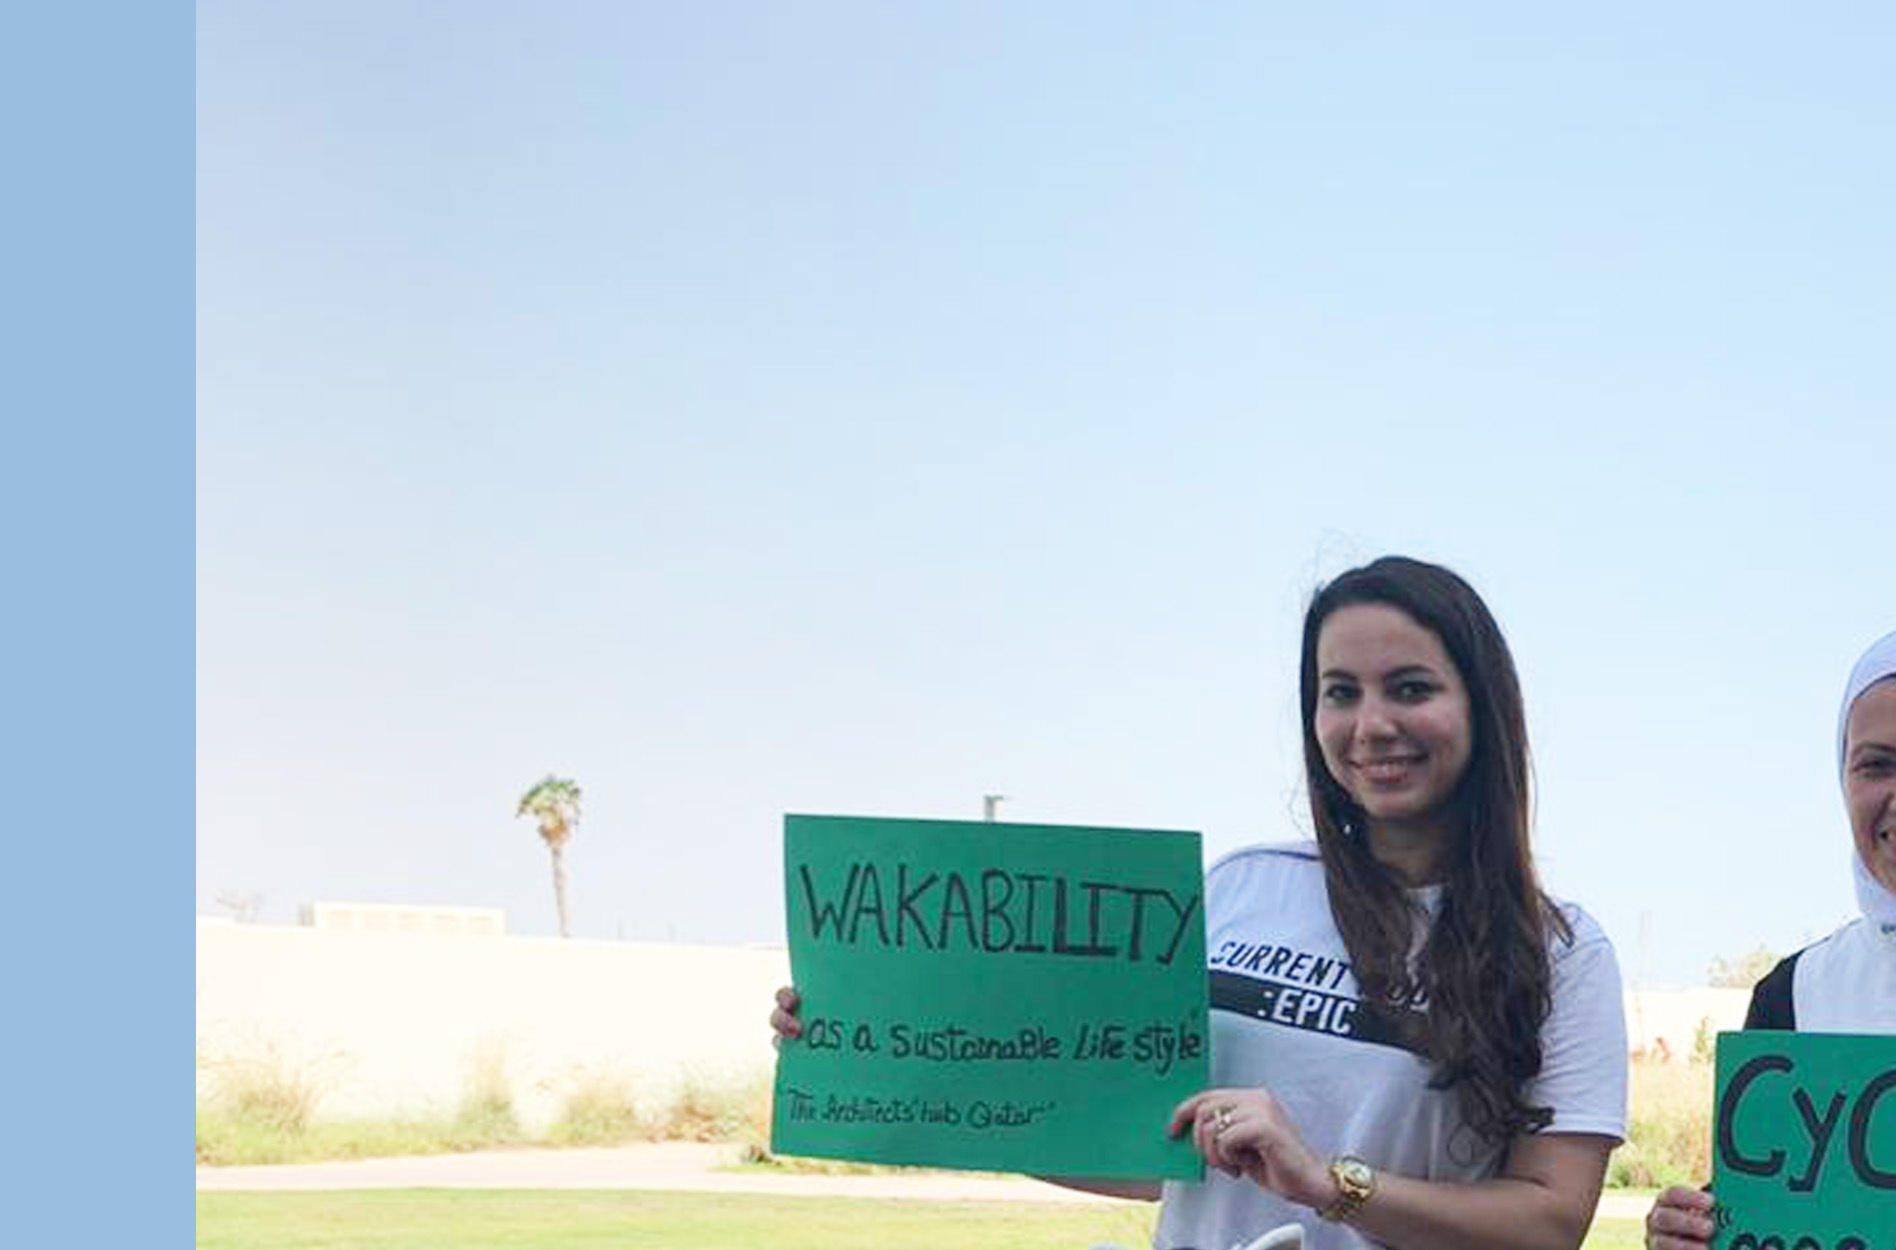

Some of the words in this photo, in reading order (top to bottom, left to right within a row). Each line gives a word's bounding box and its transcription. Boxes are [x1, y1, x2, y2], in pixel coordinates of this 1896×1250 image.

[799, 862, 1197, 965] WAKABILITY
[1210, 940, 1349, 990] CURRENT
[808, 1018, 842, 1050] as
[853, 1024, 878, 1052] a
[787, 1089, 818, 1122] The
[919, 1101, 962, 1126] hub
